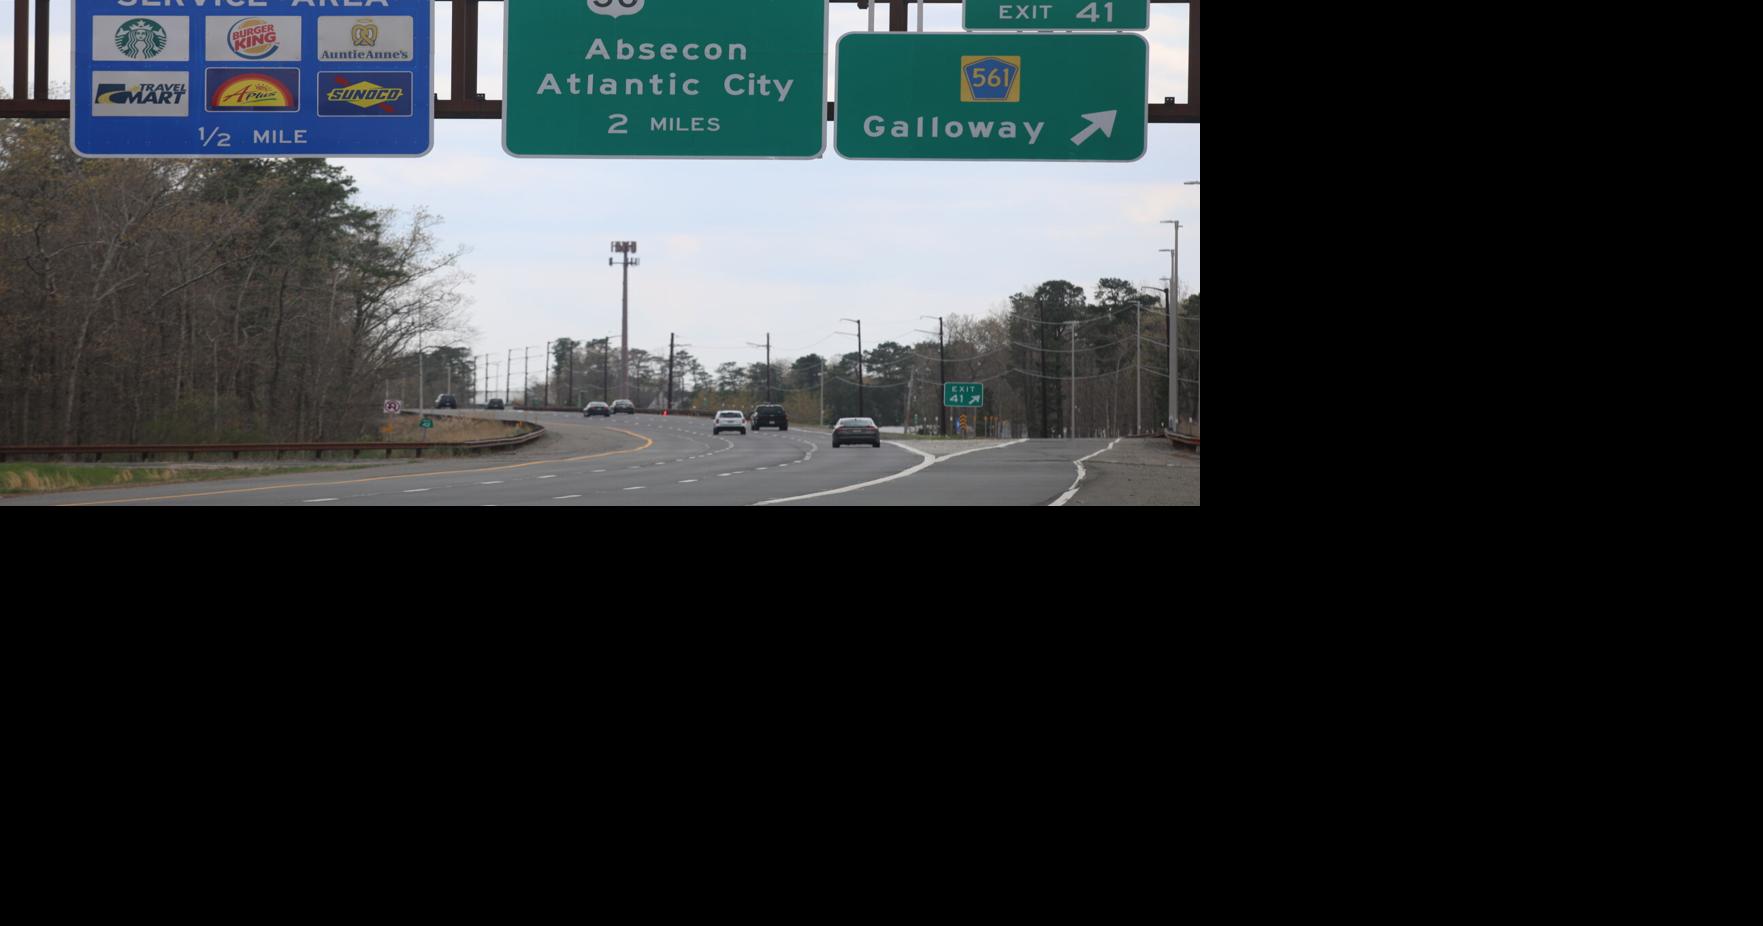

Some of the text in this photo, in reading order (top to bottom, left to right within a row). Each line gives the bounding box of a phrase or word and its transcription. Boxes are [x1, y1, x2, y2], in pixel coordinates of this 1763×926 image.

[999, 2, 1113, 22] EXIT 41
[232, 24, 274, 41] BURGER
[234, 32, 276, 52] KING
[585, 38, 747, 60] Absecon
[536, 73, 794, 102] Atlantic City
[972, 68, 1010, 88] 561
[125, 91, 186, 104] MART
[330, 89, 399, 99] SUNOCO
[607, 114, 720, 134] 2 MILES
[863, 115, 1045, 144] Galloway
[198, 127, 307, 147] 1/2 MILE
[950, 394, 964, 403] 41
